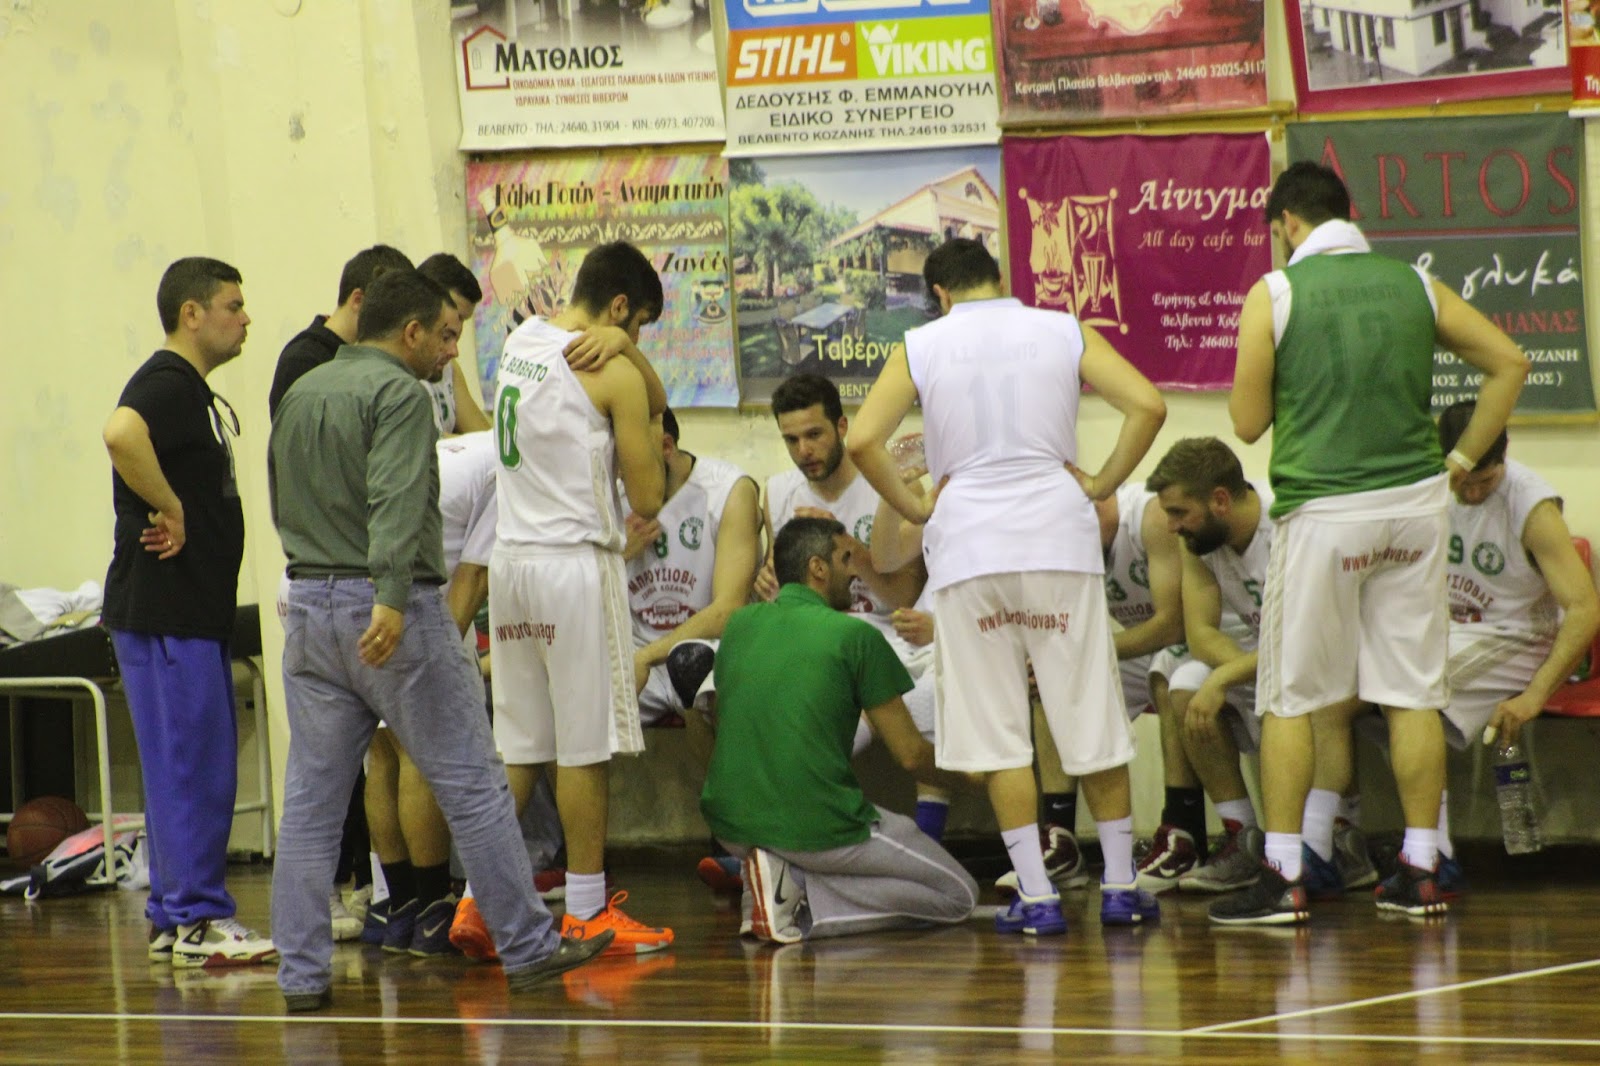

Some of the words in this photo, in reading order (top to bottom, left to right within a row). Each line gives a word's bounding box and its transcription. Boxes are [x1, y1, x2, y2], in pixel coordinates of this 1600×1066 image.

[869, 38, 987, 76] VIKING
[513, 78, 555, 90] ΟΙΚΟΔΟΜΙΚΑ
[557, 77, 575, 88] ΥΛΙΚΑ
[1015, 80, 1055, 95] Κεντρική
[1176, 64, 1207, 80] 24640
[1584, 75, 1600, 95] Τη
[515, 95, 550, 107] ΥΔΡΑΥΛΙΚΑ
[556, 93, 591, 105] ΣΥΝΘΕΣΕΙΣ
[736, 89, 832, 110] ΔΕΔΟΥΣΗΣ
[838, 88, 858, 104] Φ.
[865, 81, 994, 102] ΕΜΜΑΝΟΥΗΛ
[769, 111, 833, 128] ΕΙΔΙΚΟ
[845, 104, 954, 124] ΣΥΝΕΡΓΕΙΟ
[477, 123, 528, 136] ΒΕΛΒΕΝΤΟ
[738, 131, 809, 145] ΒΕΛΒΕΝΤΟ
[813, 128, 875, 141] ΚΟΖΑΝΗΣ
[951, 122, 986, 134] 32531
[495, 183, 541, 209] Κάβα
[546, 181, 596, 205] Ποτών
[1128, 178, 1272, 222] Αίνιγμα
[1138, 229, 1165, 250] All
[1169, 229, 1195, 252] day
[1203, 228, 1234, 252] cafe
[1244, 228, 1266, 247] bar
[1461, 249, 1579, 300] γλυκά
[1217, 312, 1240, 330] Κοζ
[1523, 348, 1578, 362] ΟΖΑΝΗ
[839, 383, 870, 397] ΒΕΝΤ
